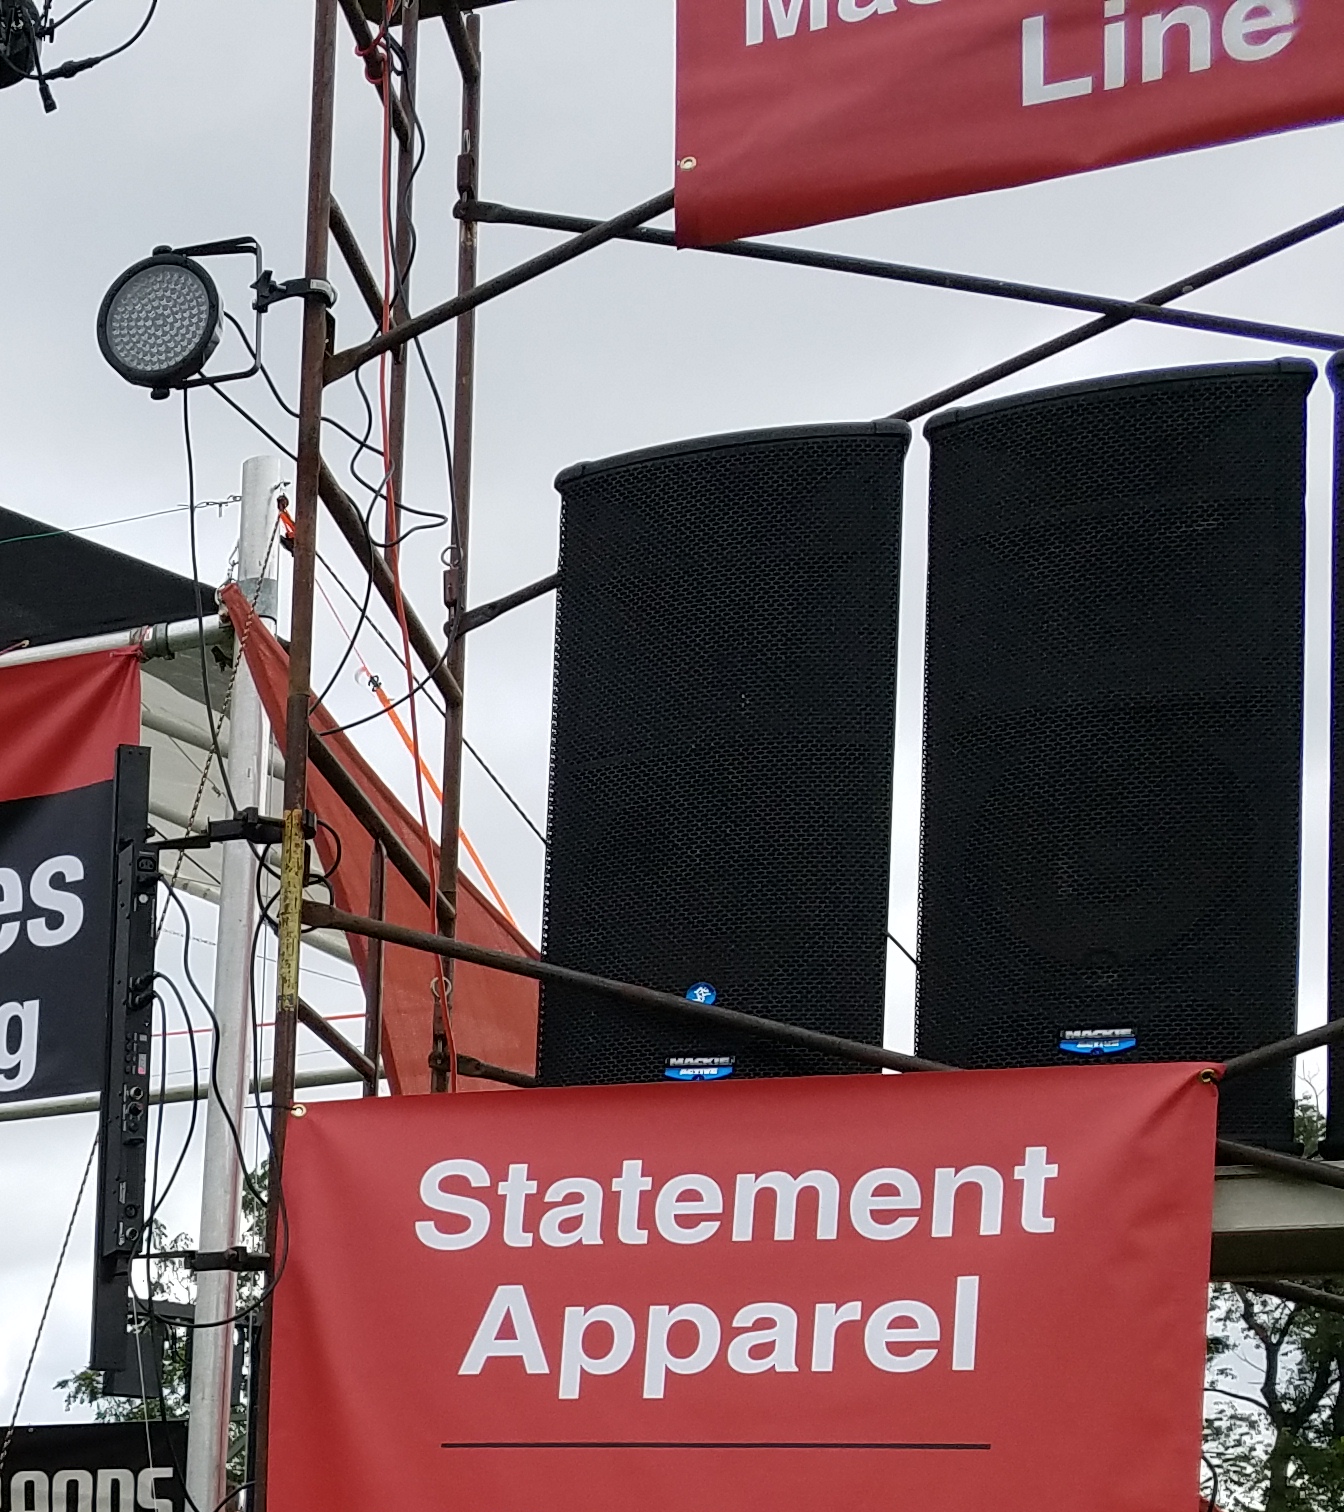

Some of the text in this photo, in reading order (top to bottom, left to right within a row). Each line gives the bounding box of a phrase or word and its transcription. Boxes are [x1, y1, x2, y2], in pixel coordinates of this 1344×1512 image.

[1022, 0, 1295, 106] Line
[414, 1145, 1059, 1251] Statement
[457, 1276, 979, 1400] Apparel
